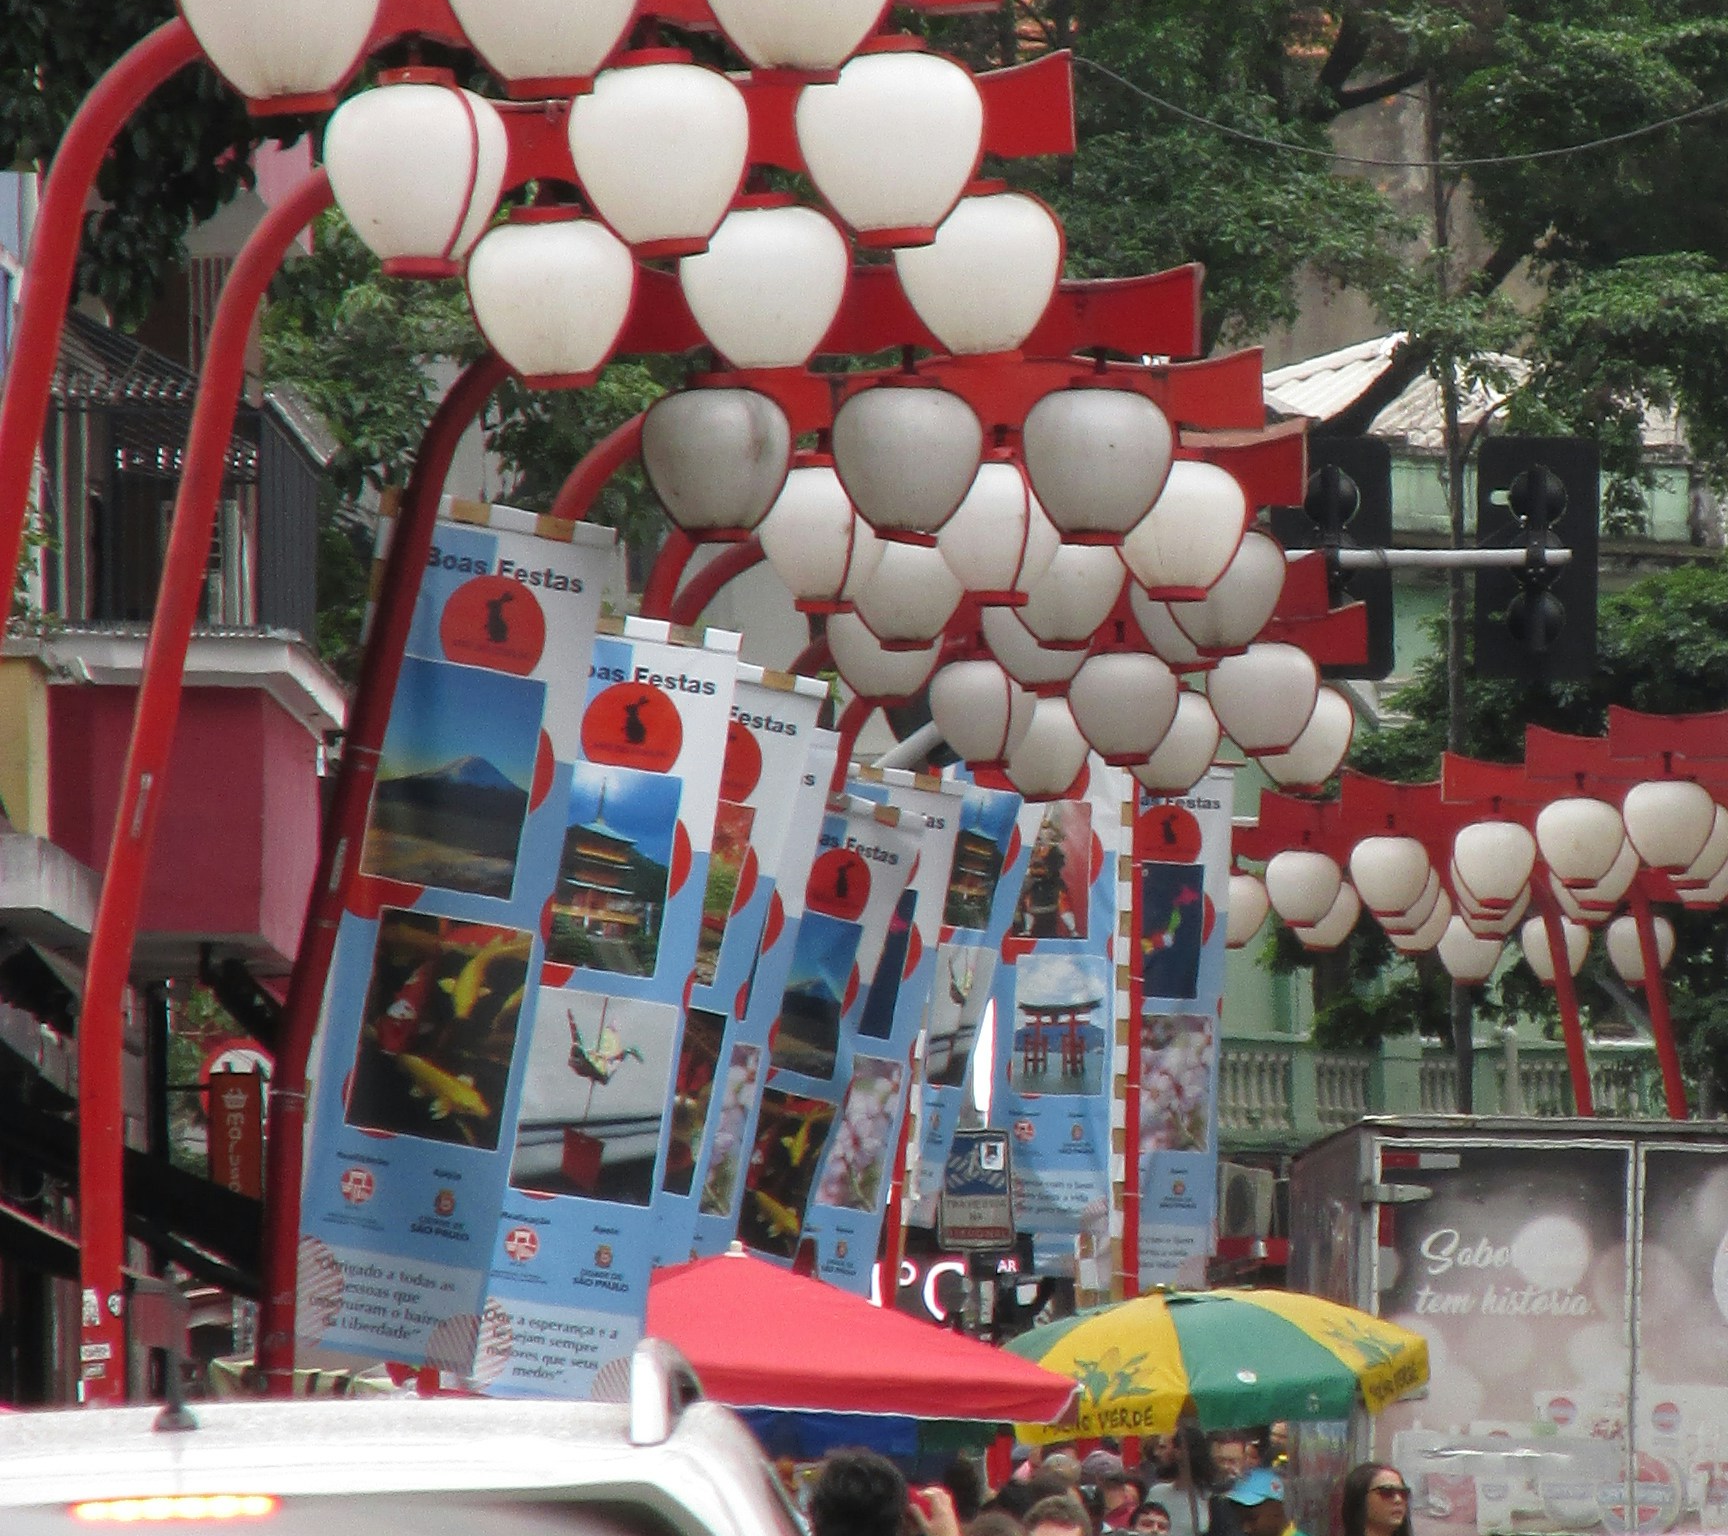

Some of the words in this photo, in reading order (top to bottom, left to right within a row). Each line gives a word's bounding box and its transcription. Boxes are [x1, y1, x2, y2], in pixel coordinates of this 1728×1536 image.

[429, 545, 488, 575] Boas
[497, 558, 584, 594] Festas
[634, 665, 715, 695] Festas
[1420, 1229, 1516, 1275] Sabo
[399, 1270, 436, 1289] todas
[393, 1287, 420, 1305] que
[1415, 1284, 1471, 1314] tem
[529, 1316, 595, 1338] esperança
[549, 1338, 598, 1354] sempre
[542, 1352, 566, 1367] que
[1097, 1404, 1154, 1431] VERDE
